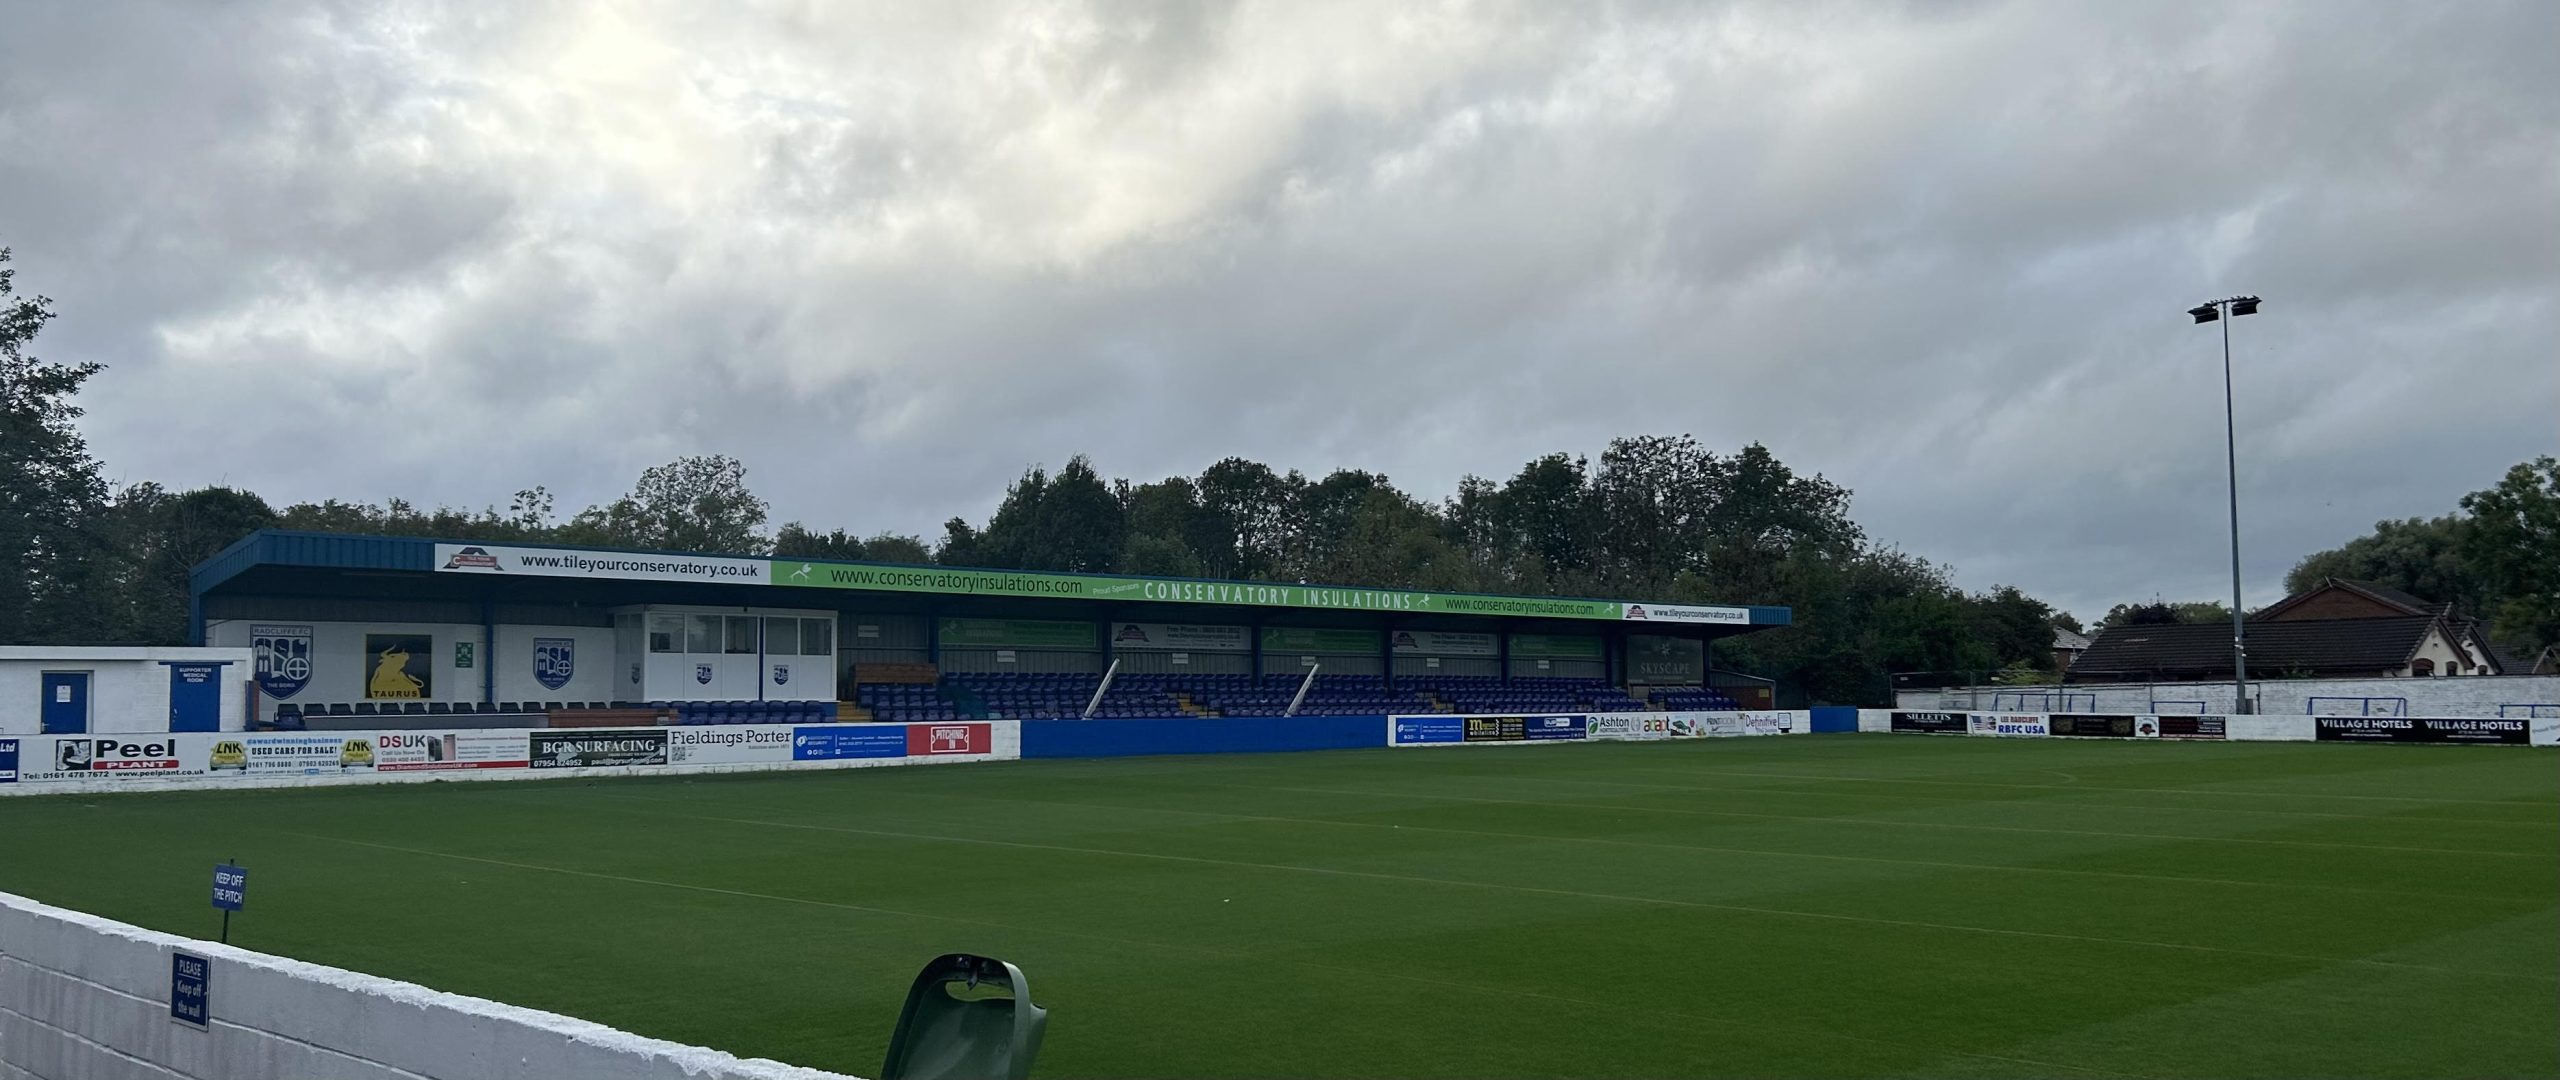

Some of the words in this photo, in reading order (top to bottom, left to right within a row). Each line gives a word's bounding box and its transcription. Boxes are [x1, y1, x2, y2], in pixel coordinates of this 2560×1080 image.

[521, 555, 758, 578] www.tileyourconservatory.co.uk
[831, 570, 1083, 593] www.conservatoryinsulations.com
[1145, 582, 1289, 604] CONSERVATORY
[1304, 590, 1410, 609] INSULATIONS
[1446, 599, 1594, 615] www.conservatoryinsulations.com
[373, 690, 418, 698] TAURUS
[1600, 716, 1629, 727] Ashton
[2321, 720, 2369, 729] VILLAGE
[2371, 720, 2413, 729] HOTELS
[2425, 720, 2478, 730] VILLAGE
[2480, 721, 2523, 731] HOTELS
[1998, 725, 2022, 734] RBFC
[2025, 725, 2046, 734] USA
[380, 735, 426, 748] DSUK
[671, 731, 743, 747] Fieldings
[746, 730, 791, 743] Porter
[96, 739, 175, 758] Peel
[216, 743, 243, 754] LNK
[275, 747, 295, 755] CARS
[346, 741, 370, 752] LNK
[542, 741, 573, 754] BGR
[575, 740, 655, 753] SURFACING
[107, 761, 167, 769] PLANT
[115, 769, 204, 778] www.peelplant.co.uk
[216, 872, 230, 885] KEEP
[231, 874, 244, 887] OFF
[214, 888, 225, 901] THE
[225, 890, 243, 904] PITCH
[178, 960, 202, 977] PLEASE
[177, 979, 192, 998] Keep
[193, 983, 202, 998] off
[177, 1000, 188, 1014] the
